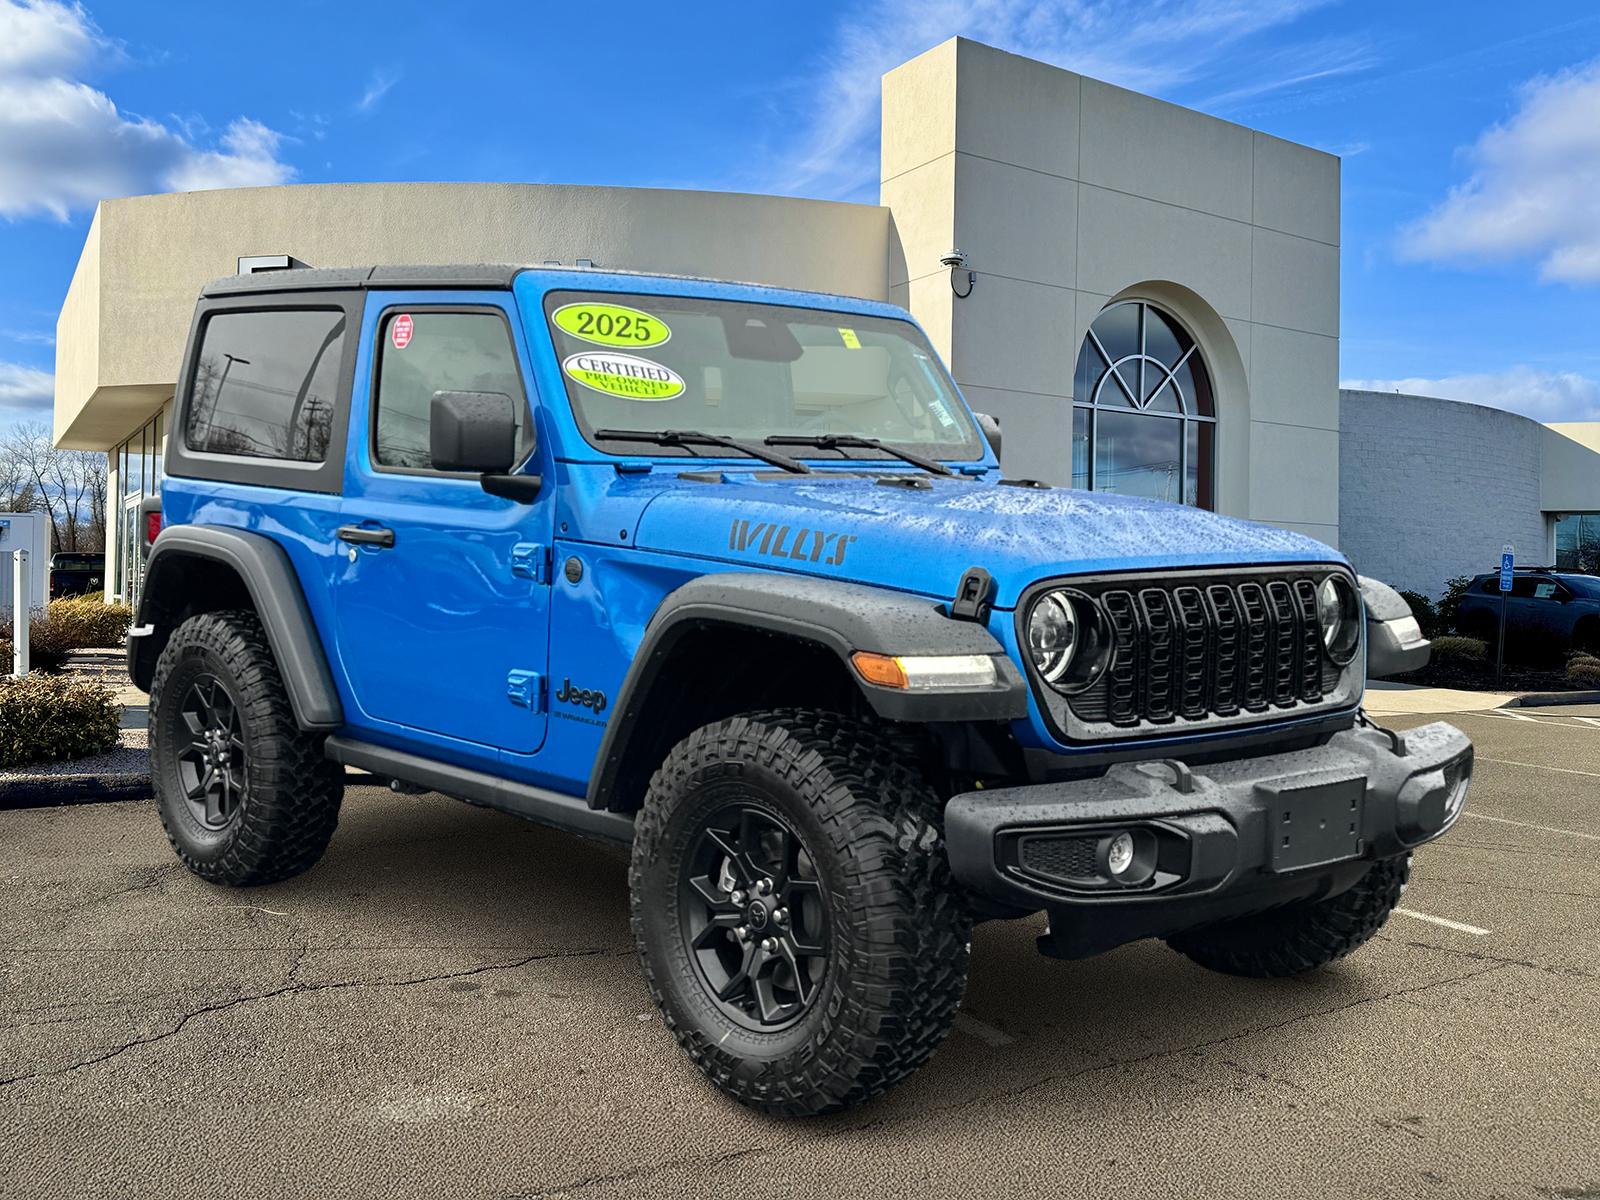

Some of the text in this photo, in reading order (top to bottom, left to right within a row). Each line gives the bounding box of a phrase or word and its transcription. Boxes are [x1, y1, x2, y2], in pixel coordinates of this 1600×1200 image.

[577, 312, 650, 341] 2025
[577, 358, 670, 382] CERTIFIED
[585, 372, 669, 391] PRE-OWNED
[600, 381, 658, 395] VEHICLE
[729, 519, 857, 565] WILLYS
[556, 677, 606, 715] Jeep
